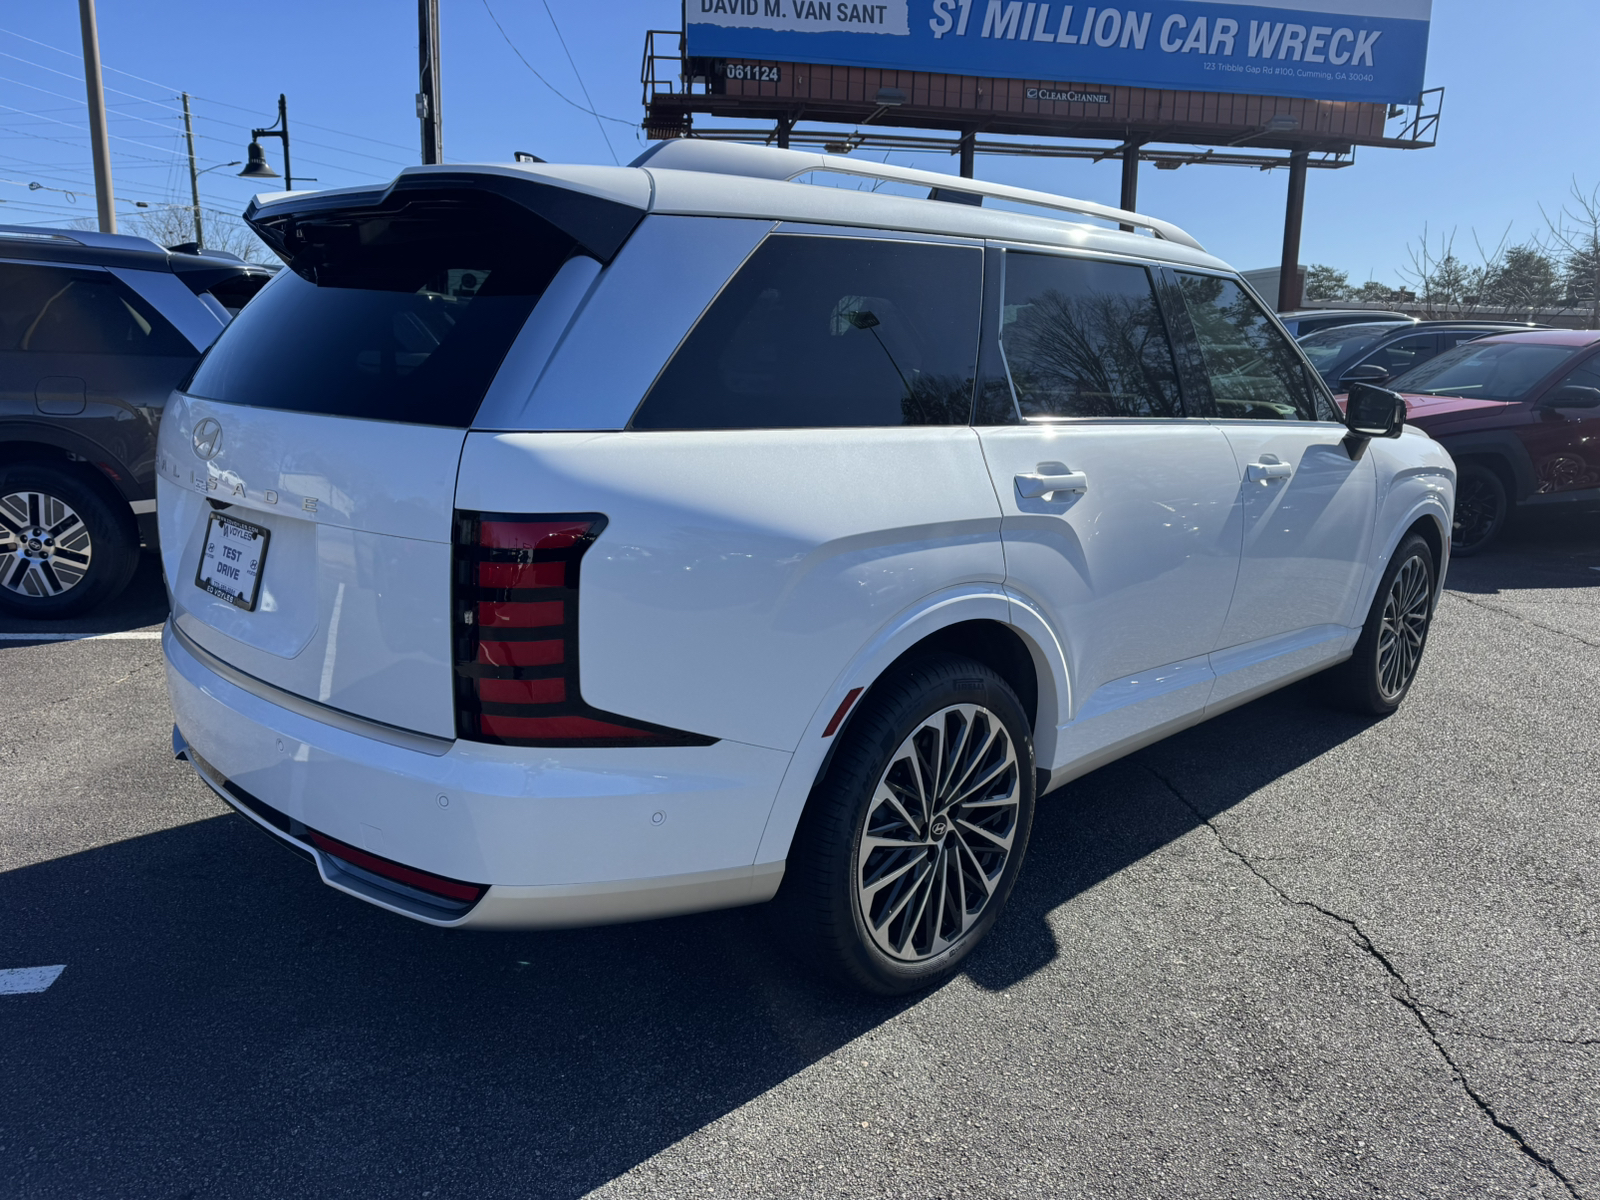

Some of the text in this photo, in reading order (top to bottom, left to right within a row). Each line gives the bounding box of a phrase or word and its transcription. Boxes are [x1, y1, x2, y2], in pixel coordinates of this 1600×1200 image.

[701, 0, 888, 25] DAVID M. VAN SANT
[929, 0, 1382, 67] $1 MILLION CAR WRECK
[726, 64, 779, 82] 061124
[1203, 62, 1374, 82] 123 Tribble Gap Rd #100, Cumming, GA 30040
[222, 545, 242, 562] TEST
[216, 561, 241, 581] DRIVE
[214, 588, 234, 603] VOYLES
